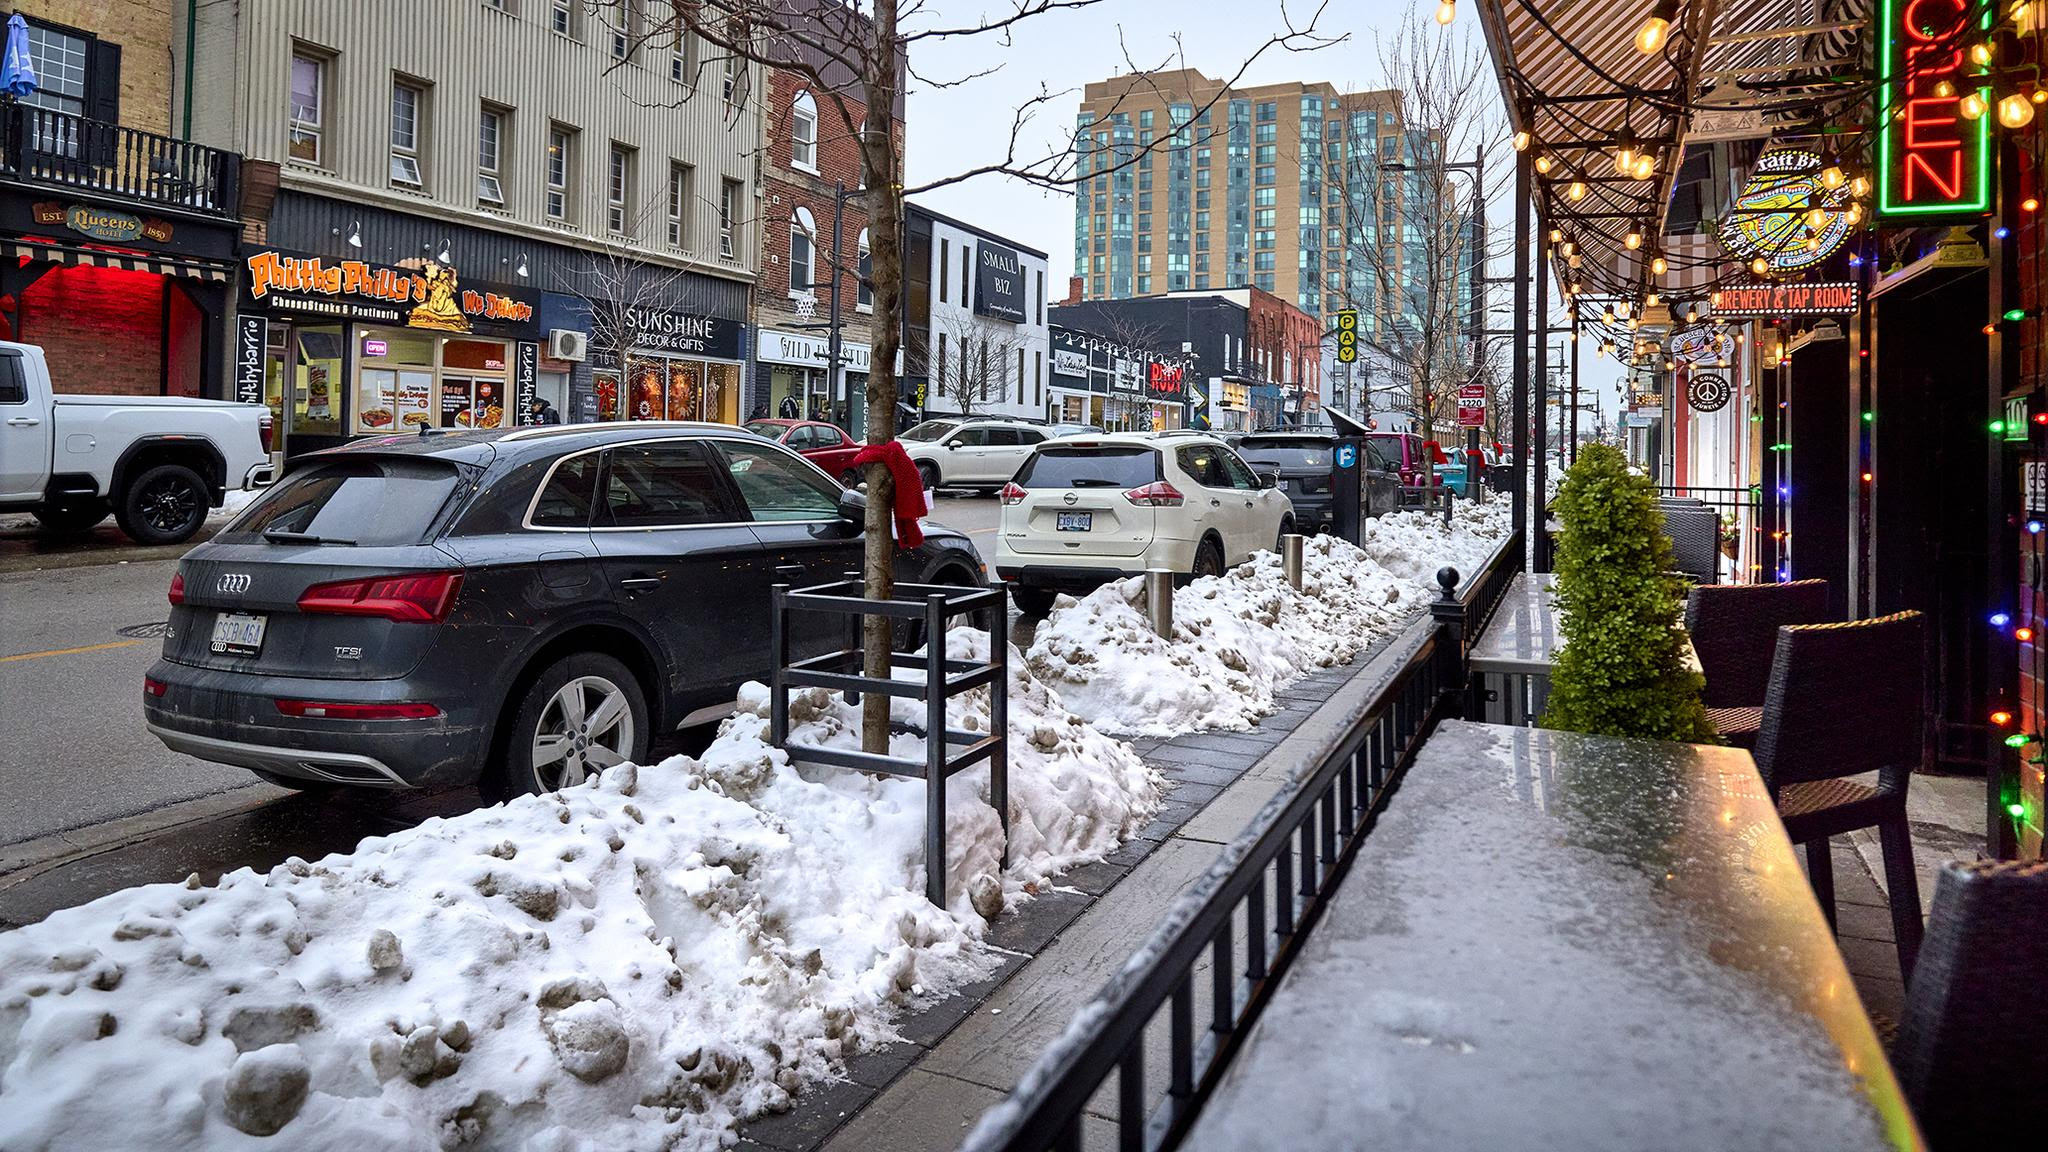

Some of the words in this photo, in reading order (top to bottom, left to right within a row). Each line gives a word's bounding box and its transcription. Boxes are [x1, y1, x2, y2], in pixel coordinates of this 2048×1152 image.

[1904, 0, 1966, 201] OPEN
[1758, 153, 1794, 172] raft
[42, 212, 63, 221] EST.
[75, 209, 136, 230] Queens
[96, 228, 122, 238] HOTEL
[147, 226, 166, 240] 1850
[983, 249, 1017, 275] SMALL
[248, 251, 341, 300] Philthy
[341, 260, 428, 303] Philly's
[994, 277, 1012, 296] BIZ
[463, 289, 484, 315] We
[485, 292, 533, 322] Deliver
[1773, 289, 1784, 309] &
[1787, 287, 1811, 308] TAP
[1814, 287, 1852, 308] ROOM
[625, 308, 714, 339] SUNSHINE
[637, 332, 669, 347] DECOR
[671, 337, 678, 348] &
[679, 338, 704, 352] GIFTS
[1342, 317, 1352, 360] PAY
[780, 336, 811, 360] WILD
[817, 344, 830, 361] IN
[843, 347, 870, 366] STUD
[1151, 363, 1182, 393] RUDY
[1688, 380, 1699, 401] HUMAN
[1699, 375, 1728, 401] CONNECTION
[1694, 402, 1719, 410] JUNKIE
[214, 621, 239, 642] CSCB
[242, 623, 262, 644] 464
[334, 646, 362, 655] TFSI
